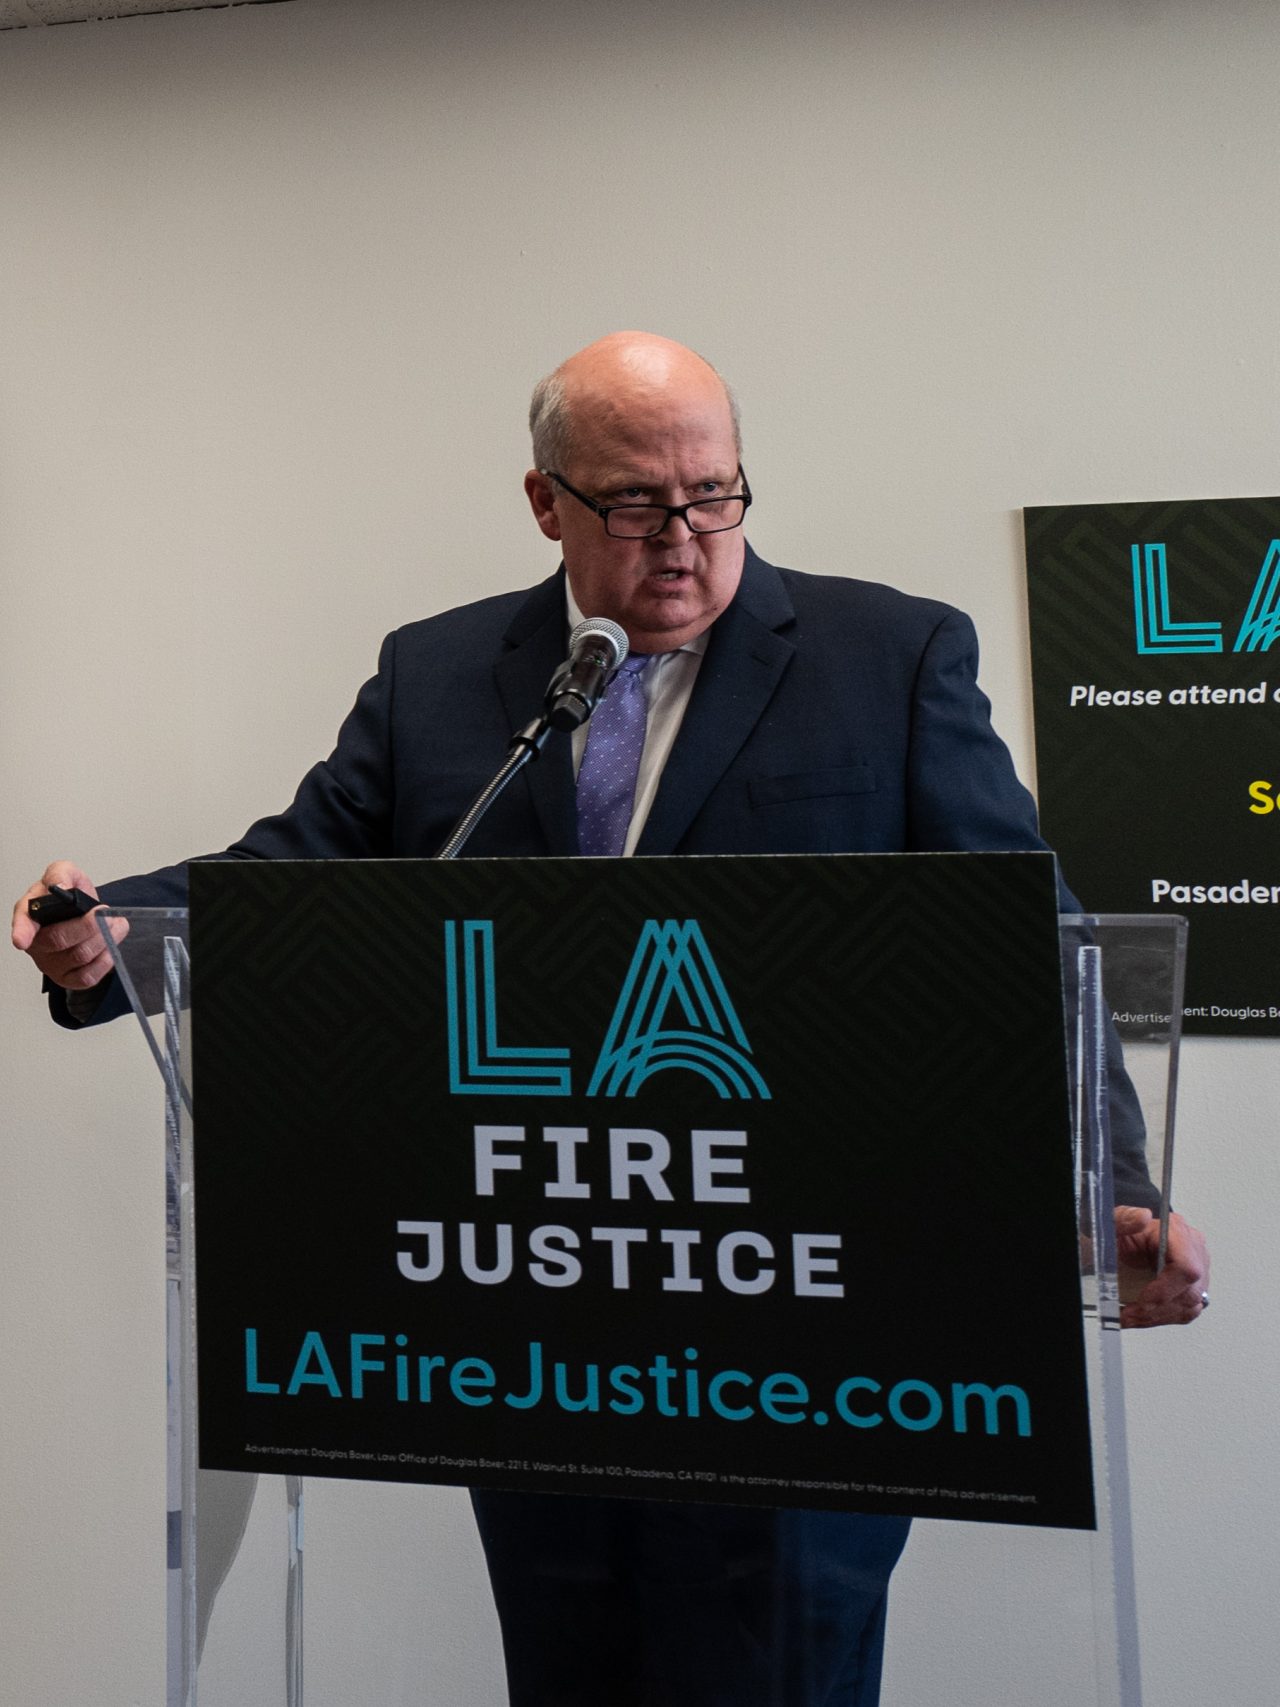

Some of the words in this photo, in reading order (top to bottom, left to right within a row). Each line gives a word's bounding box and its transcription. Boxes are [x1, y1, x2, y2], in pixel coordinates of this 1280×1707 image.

[1070, 684, 1162, 706] Please
[1169, 682, 1267, 705] attend
[1248, 781, 1280, 815] S
[444, 919, 772, 1100] LA
[1111, 1007, 1209, 1023] Advertiseent:
[1211, 1006, 1267, 1020] Douglas
[473, 1125, 751, 1204] FIRE
[396, 1220, 845, 1298] JUSTICE
[245, 1328, 1032, 1437] LAFireJustice.com
[312, 1447, 348, 1460] Douglas
[378, 1452, 396, 1462] Law
[399, 1453, 427, 1464] Office
[429, 1455, 439, 1464] of
[440, 1456, 478, 1469] Douglas
[533, 1462, 567, 1472] Walnut
[581, 1464, 604, 1475] Suite
[677, 1470, 693, 1480] CA
[729, 1475, 746, 1484] the
[747, 1476, 790, 1488] attorney
[791, 1480, 849, 1491] responsible
[851, 1482, 865, 1491] for
[867, 1483, 883, 1493] the
[886, 1485, 925, 1496] content
[927, 1487, 937, 1496] of
[940, 1488, 958, 1498] this
